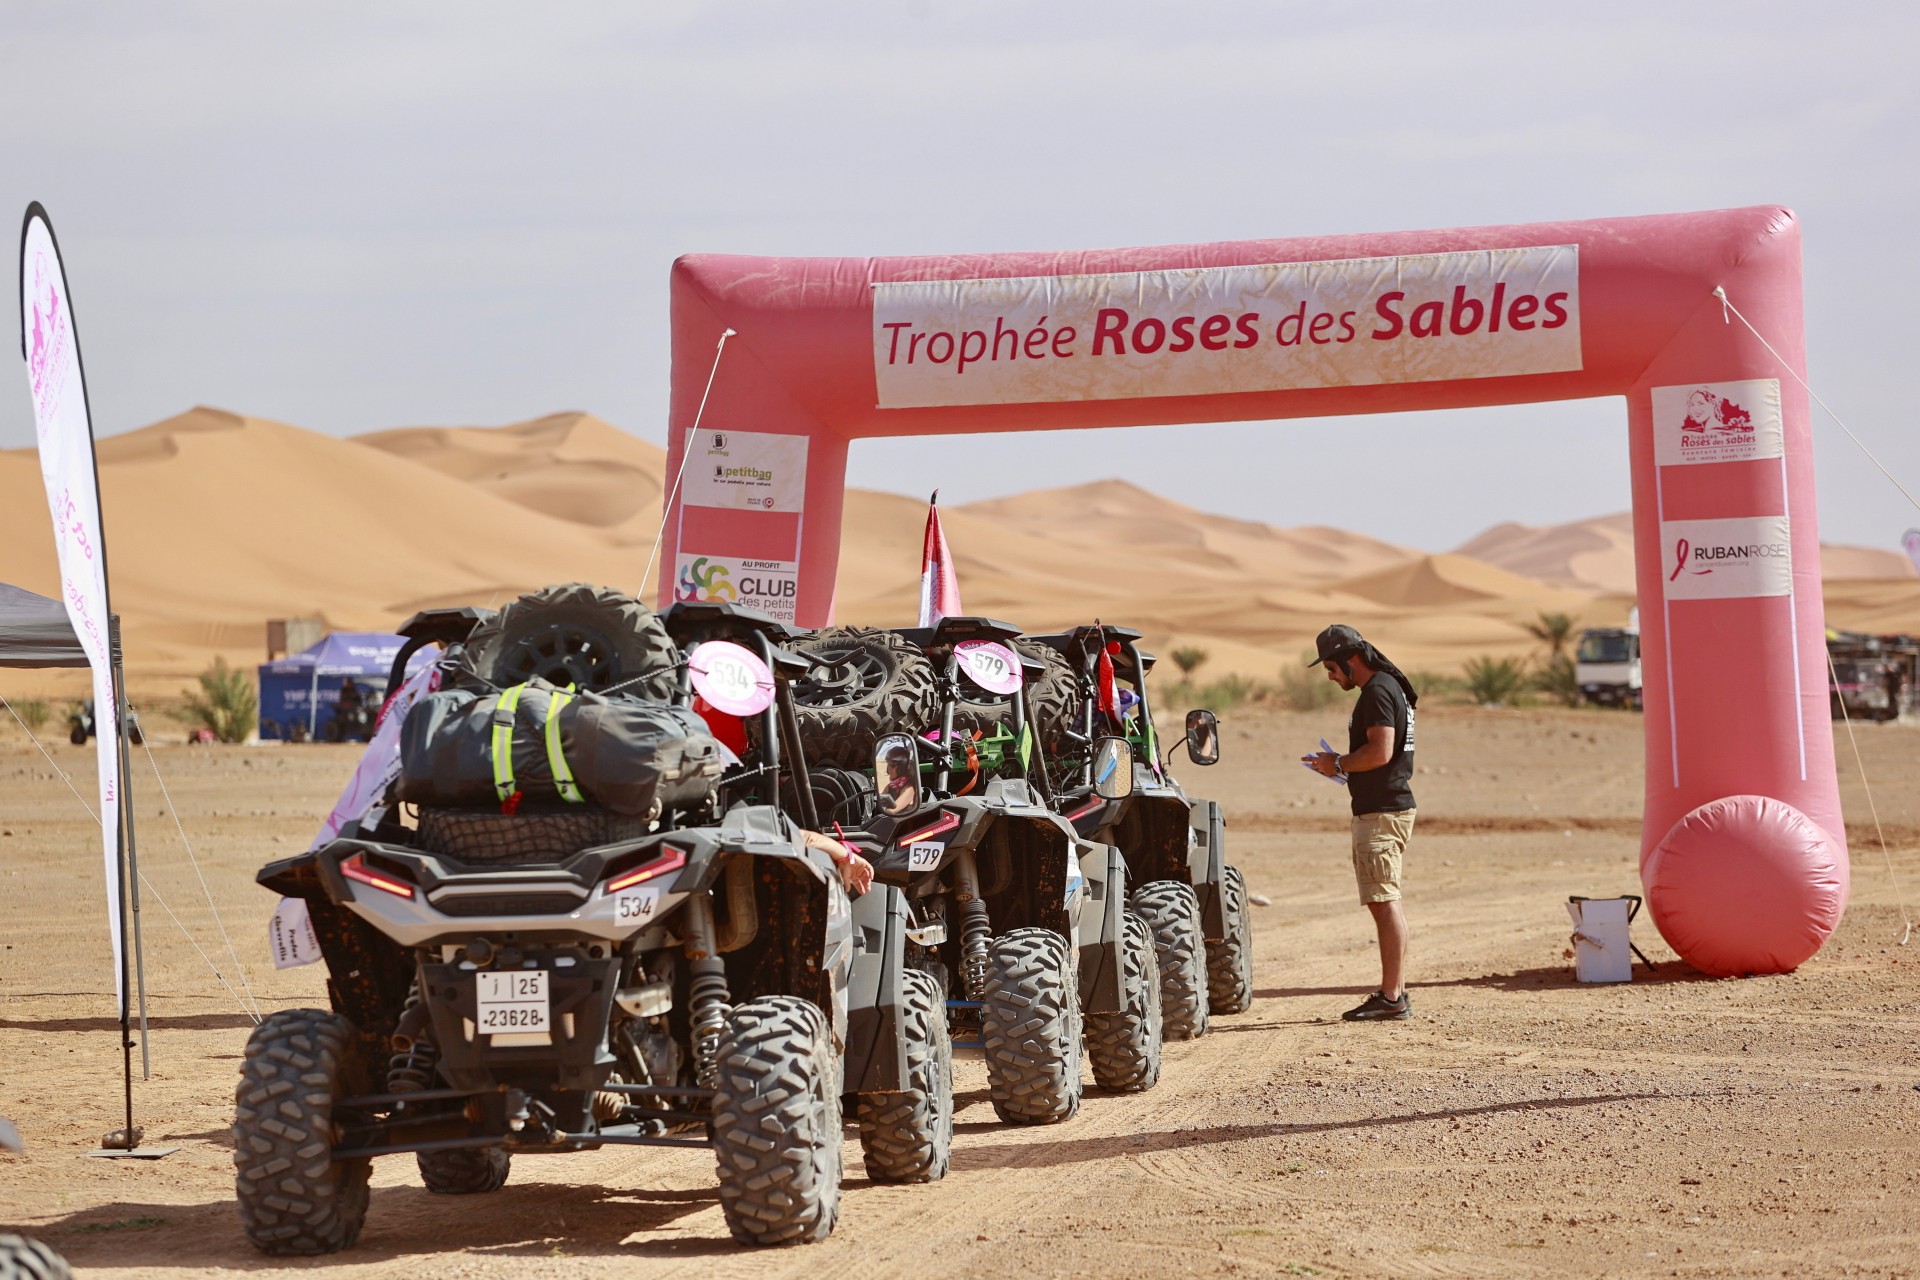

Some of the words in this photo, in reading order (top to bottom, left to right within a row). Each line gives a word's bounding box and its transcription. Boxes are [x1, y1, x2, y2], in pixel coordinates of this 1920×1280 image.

[882, 316, 1077, 374] Trophée
[1091, 306, 1260, 356] Roses
[1275, 301, 1357, 345] des
[1371, 282, 1569, 341] Sables
[1681, 434, 1711, 447] Roses
[1726, 434, 1756, 445] sables
[726, 467, 772, 481] petitbag
[754, 561, 781, 569] PROFIT
[739, 577, 796, 597] CLUB
[738, 596, 760, 607] des
[763, 597, 795, 610] petits
[974, 652, 1004, 676] 579
[714, 661, 750, 689] 534
[913, 848, 940, 865] 579
[620, 896, 652, 918] 534
[519, 977, 539, 995] 25
[488, 1009, 540, 1027] 23628
